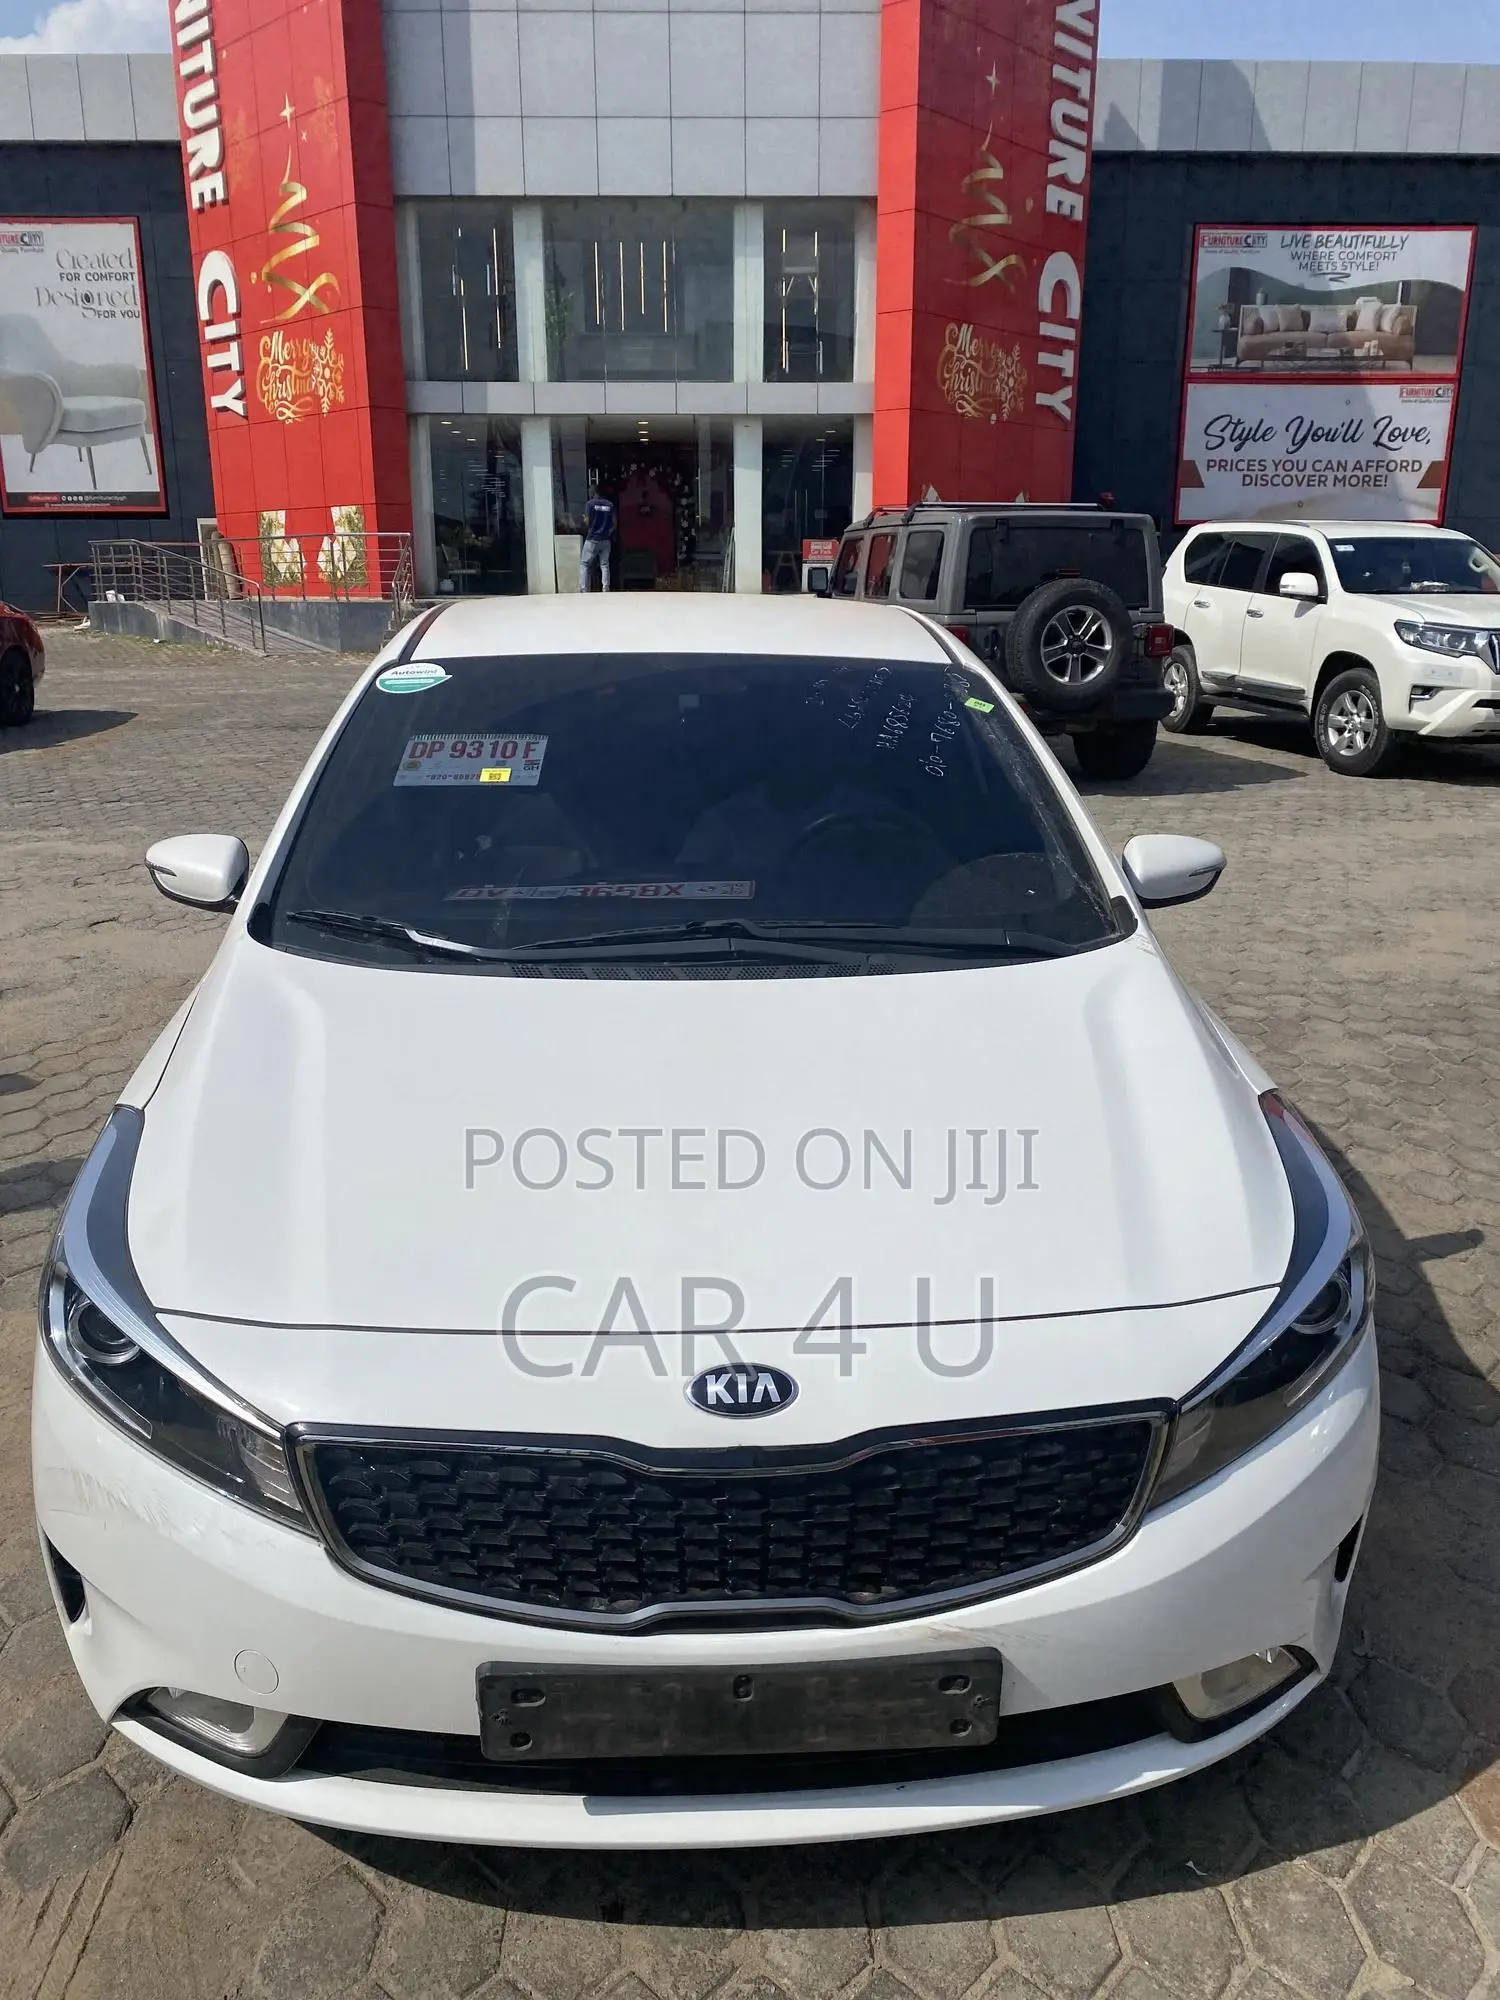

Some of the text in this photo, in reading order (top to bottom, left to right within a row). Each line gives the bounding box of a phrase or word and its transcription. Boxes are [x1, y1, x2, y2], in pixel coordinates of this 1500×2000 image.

[1280, 234, 1409, 250] LIVE BEAUTIFULLY
[56, 247, 134, 270] Created
[1290, 251, 1398, 261] WHERE COMFORT
[1298, 261, 1379, 271] MEETS STYLE!
[60, 272, 135, 281] FOR COMFORT
[35, 284, 138, 319] Designed
[97, 310, 140, 318] FOR YOU
[198, 250, 246, 417] CITY
[1036, 251, 1081, 423] CITY
[1204, 414, 1431, 455] Style You'll Love,
[1206, 459, 1423, 473] PRICES YOU CAN AFFORD
[1242, 473, 1388, 488] DISCOVER MORE!
[391, 669, 438, 677] Autowini
[408, 740, 540, 759] DP 9310 F
[706, 1373, 781, 1405] KIA
